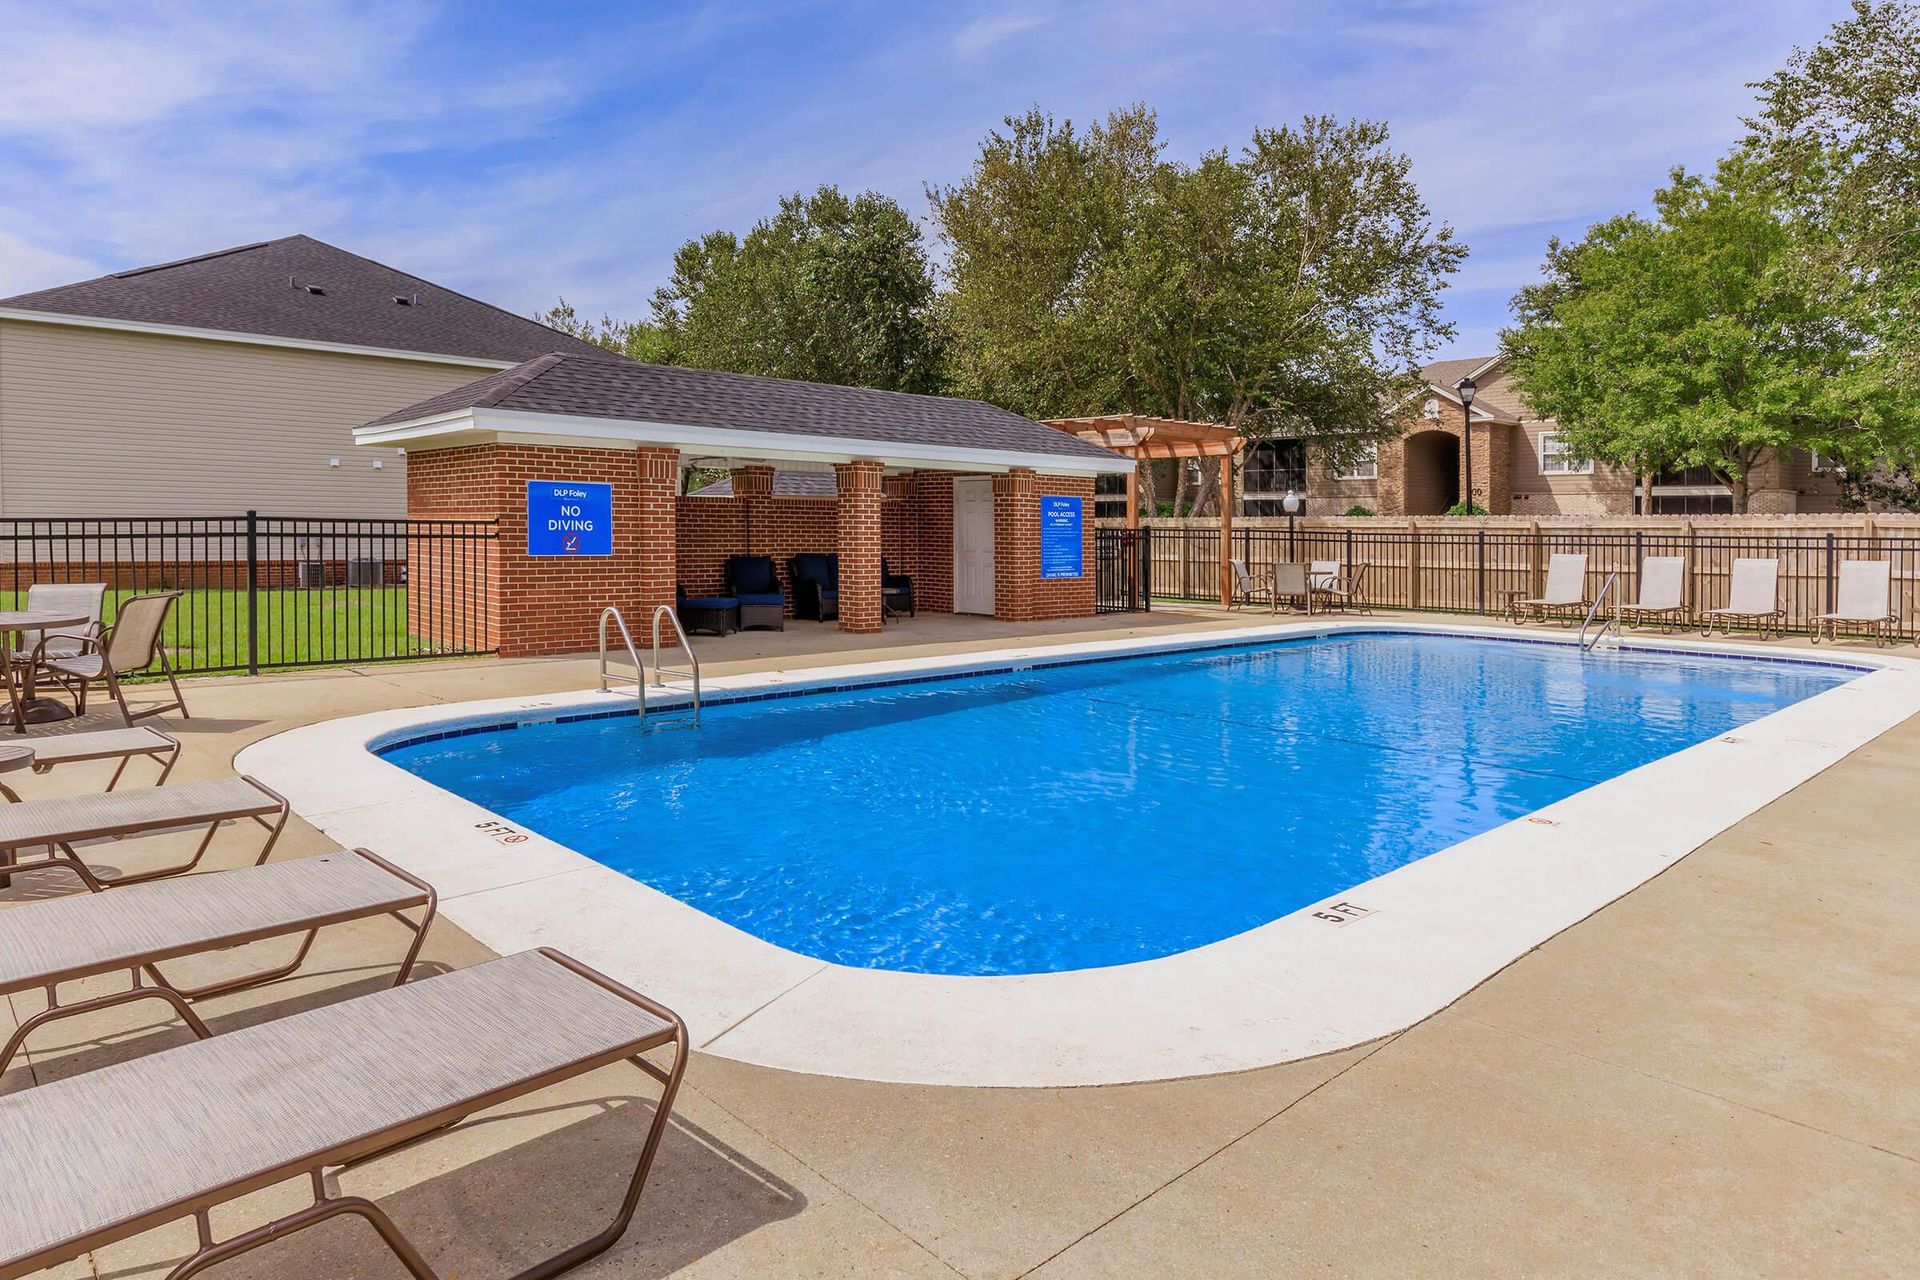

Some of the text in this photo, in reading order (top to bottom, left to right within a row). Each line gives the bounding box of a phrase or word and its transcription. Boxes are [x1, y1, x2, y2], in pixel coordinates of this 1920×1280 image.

[569, 490, 587, 498] Foley
[561, 505, 581, 517] NO
[548, 520, 593, 531] DIVING
[484, 827, 516, 836] FT
[1311, 902, 1369, 923] 5 FT
